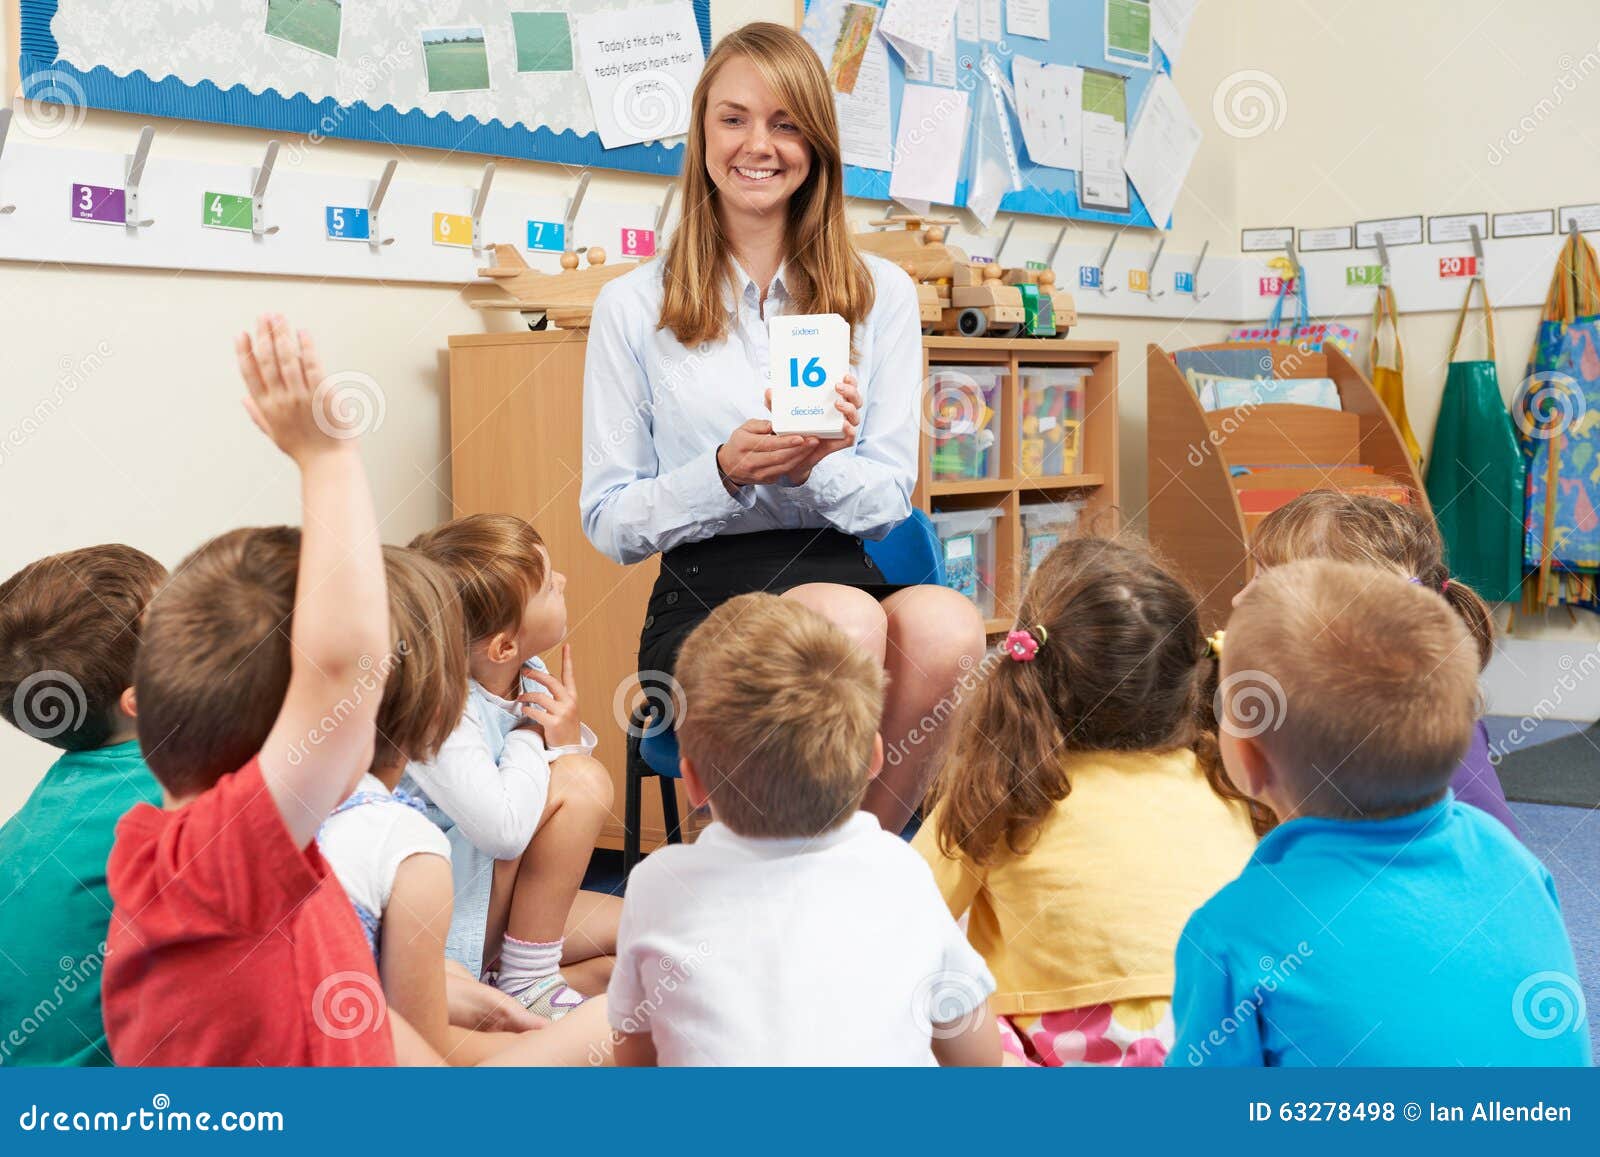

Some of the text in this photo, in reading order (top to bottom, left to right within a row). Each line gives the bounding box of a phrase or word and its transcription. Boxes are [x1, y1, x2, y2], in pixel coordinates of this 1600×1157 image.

[597, 31, 682, 54] Today's the day the
[595, 52, 694, 79] teddy bears have their
[79, 186, 93, 210] 3
[210, 195, 223, 217] 4
[333, 208, 345, 230] 5
[440, 215, 451, 236] 6
[533, 222, 545, 241] 7
[627, 230, 637, 249] 8
[1081, 266, 1093, 282] 15
[1349, 267, 1367, 281] 19
[1440, 257, 1461, 273] 20
[1177, 273, 1188, 287] 17
[1261, 277, 1280, 292] 18
[791, 326, 819, 336] sixteen
[789, 356, 827, 388] 16
